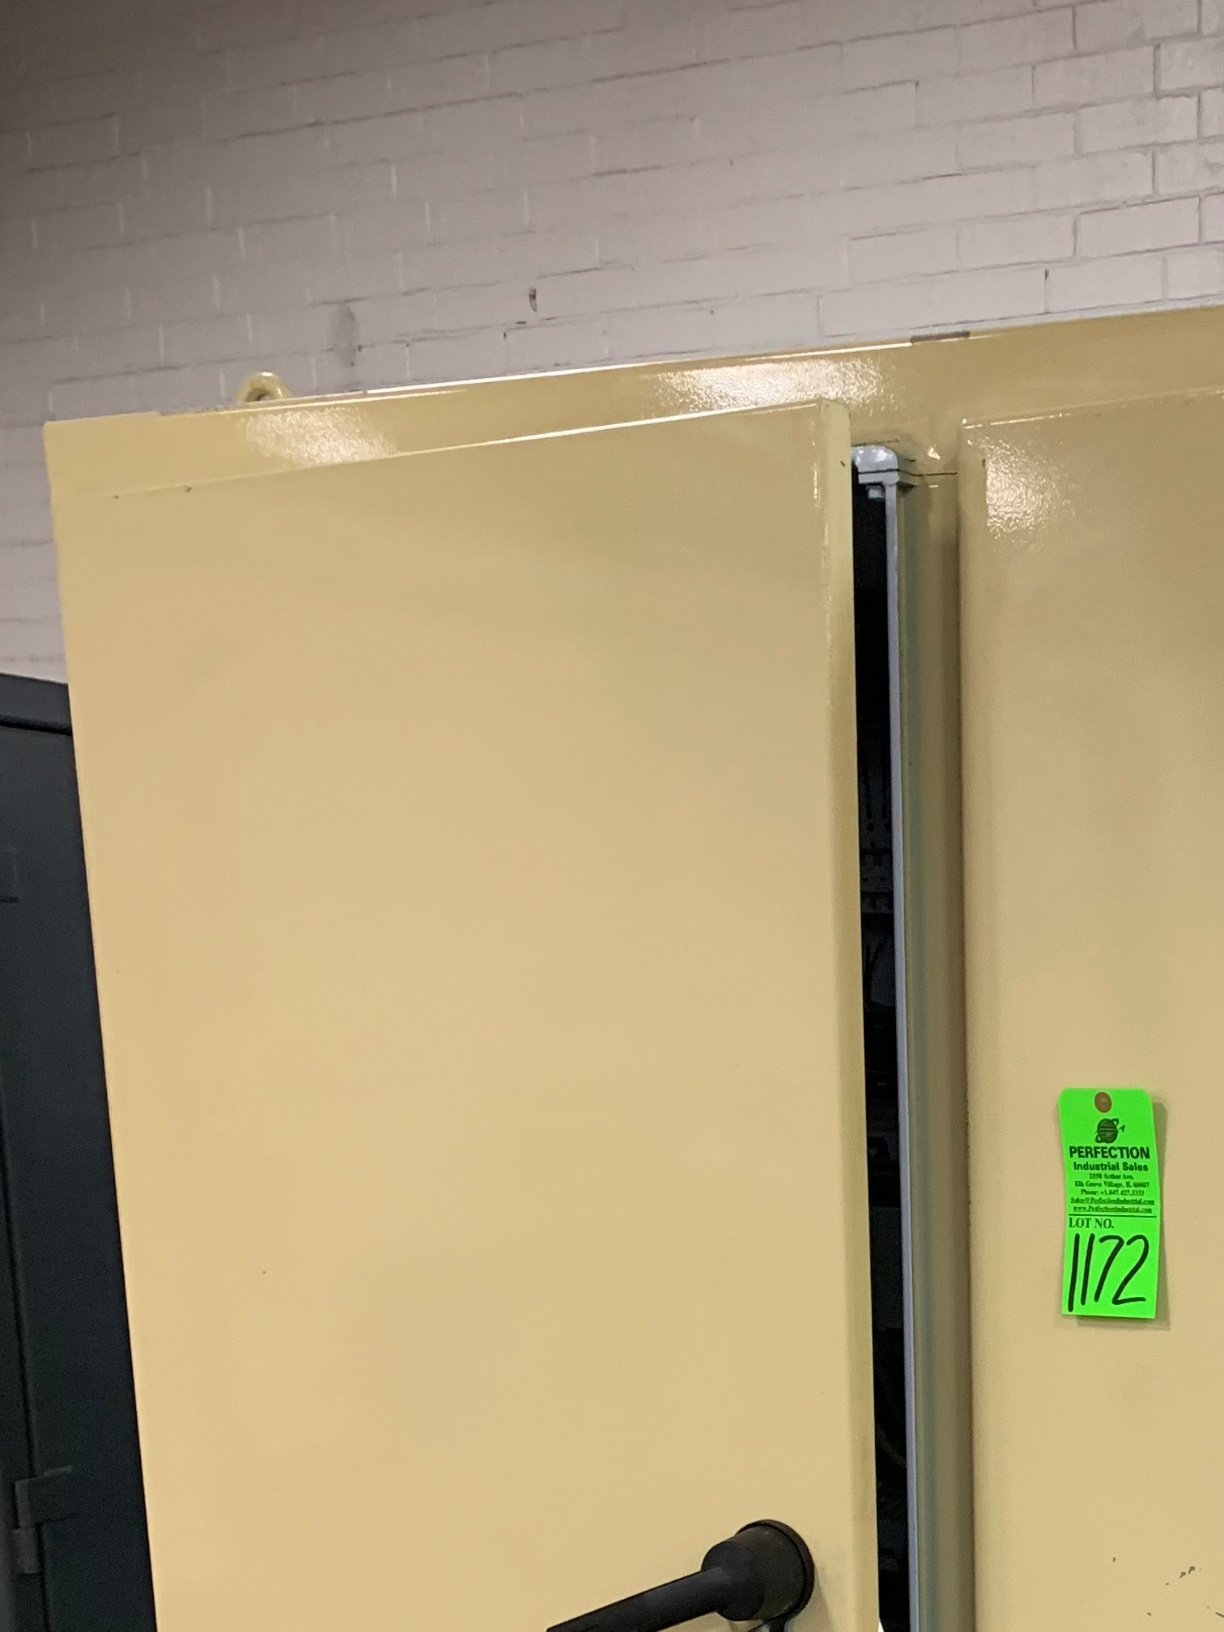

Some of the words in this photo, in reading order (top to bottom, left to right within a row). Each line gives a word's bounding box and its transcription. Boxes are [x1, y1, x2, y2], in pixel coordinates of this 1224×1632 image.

[1068, 1146, 1150, 1159] PERFECTION
[1073, 1161, 1120, 1171] Industrial
[1122, 1162, 1148, 1172] Sales
[1085, 1180, 1102, 1188] Grove
[1068, 1217, 1092, 1229] LOT
[1095, 1218, 1115, 1229] NO.
[1068, 1232, 1149, 1312] 1172
